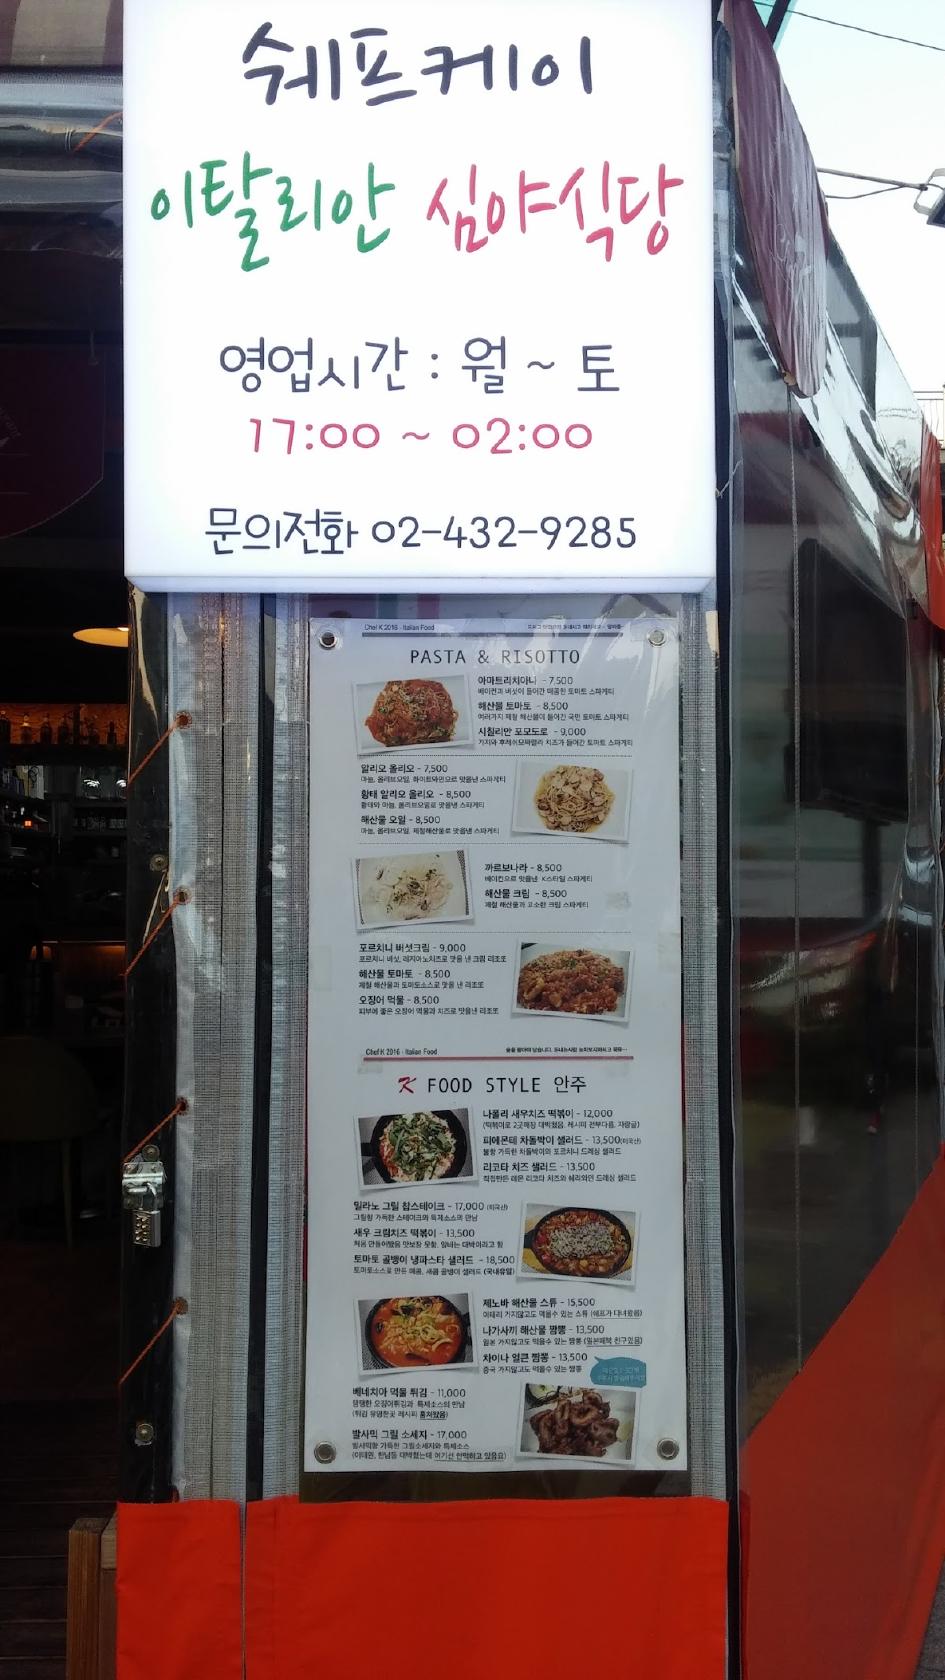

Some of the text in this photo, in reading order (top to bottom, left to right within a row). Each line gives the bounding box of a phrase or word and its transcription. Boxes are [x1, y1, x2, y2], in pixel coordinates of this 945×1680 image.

[244, 22, 594, 105] 쉐프케이
[152, 152, 395, 272] 이탈리안
[426, 161, 684, 262] 심야식당
[220, 338, 408, 392] 영업시간
[462, 336, 506, 394] 월
[578, 345, 619, 391] 토
[250, 418, 379, 454] 17:00
[453, 418, 592, 454] 02:00
[205, 508, 636, 555] 문의전화 02-432-9285
[411, 650, 579, 663] PASTA & RISOTTO
[478, 676, 573, 685] 아마트리치아니 7,500
[478, 702, 568, 711] 해산물 토마토 8,500
[478, 727, 586, 736] 시칠리안 포모도로 9,000
[361, 764, 448, 773] 알리오 올리오 7,500
[361, 790, 471, 799] 황태 알리오 올리오 8,500
[361, 816, 440, 825] 해산물 오일 8,500
[485, 864, 562, 872] 까르보나라 8,500
[485, 889, 567, 898] 해산물 크림 8,500
[359, 943, 465, 952] 포르치니 버섯크림 9,000
[359, 969, 450, 978] 해산물 토마토 8,500
[359, 995, 439, 1005] 오징어 먹물 8,500
[427, 1078, 472, 1092] FOOD
[486, 1078, 541, 1092] STYLE
[554, 1076, 586, 1093] 안주
[483, 1109, 612, 1119] 나폴리 새우치즈 떡볶이 12,000
[483, 1135, 583, 1145] 피에몬테 차돌박이 샐러드
[484, 1162, 595, 1172] 리코타 치즈 샐러드 13,500
[354, 1202, 484, 1211] 밀라노 그릴 찹스테이크 17,000
[354, 1228, 474, 1238] 새우 크림치즈 떡볶이 13,500
[354, 1255, 514, 1265] 토마토 골뱅이 냉파스타 샐러드 18,500
[483, 1298, 595, 1308] 제노바 해산물 스튜 15,500
[483, 1325, 604, 1335] 나가사끼 해산물 짬뽕 13,500
[483, 1353, 587, 1363] 차이나 얼큰 짬뽕 13,500
[353, 1387, 466, 1398] 베네치아 먹물 튀김 11,000
[352, 1430, 466, 1439] 발사믹 그릴 소세지 17,000
